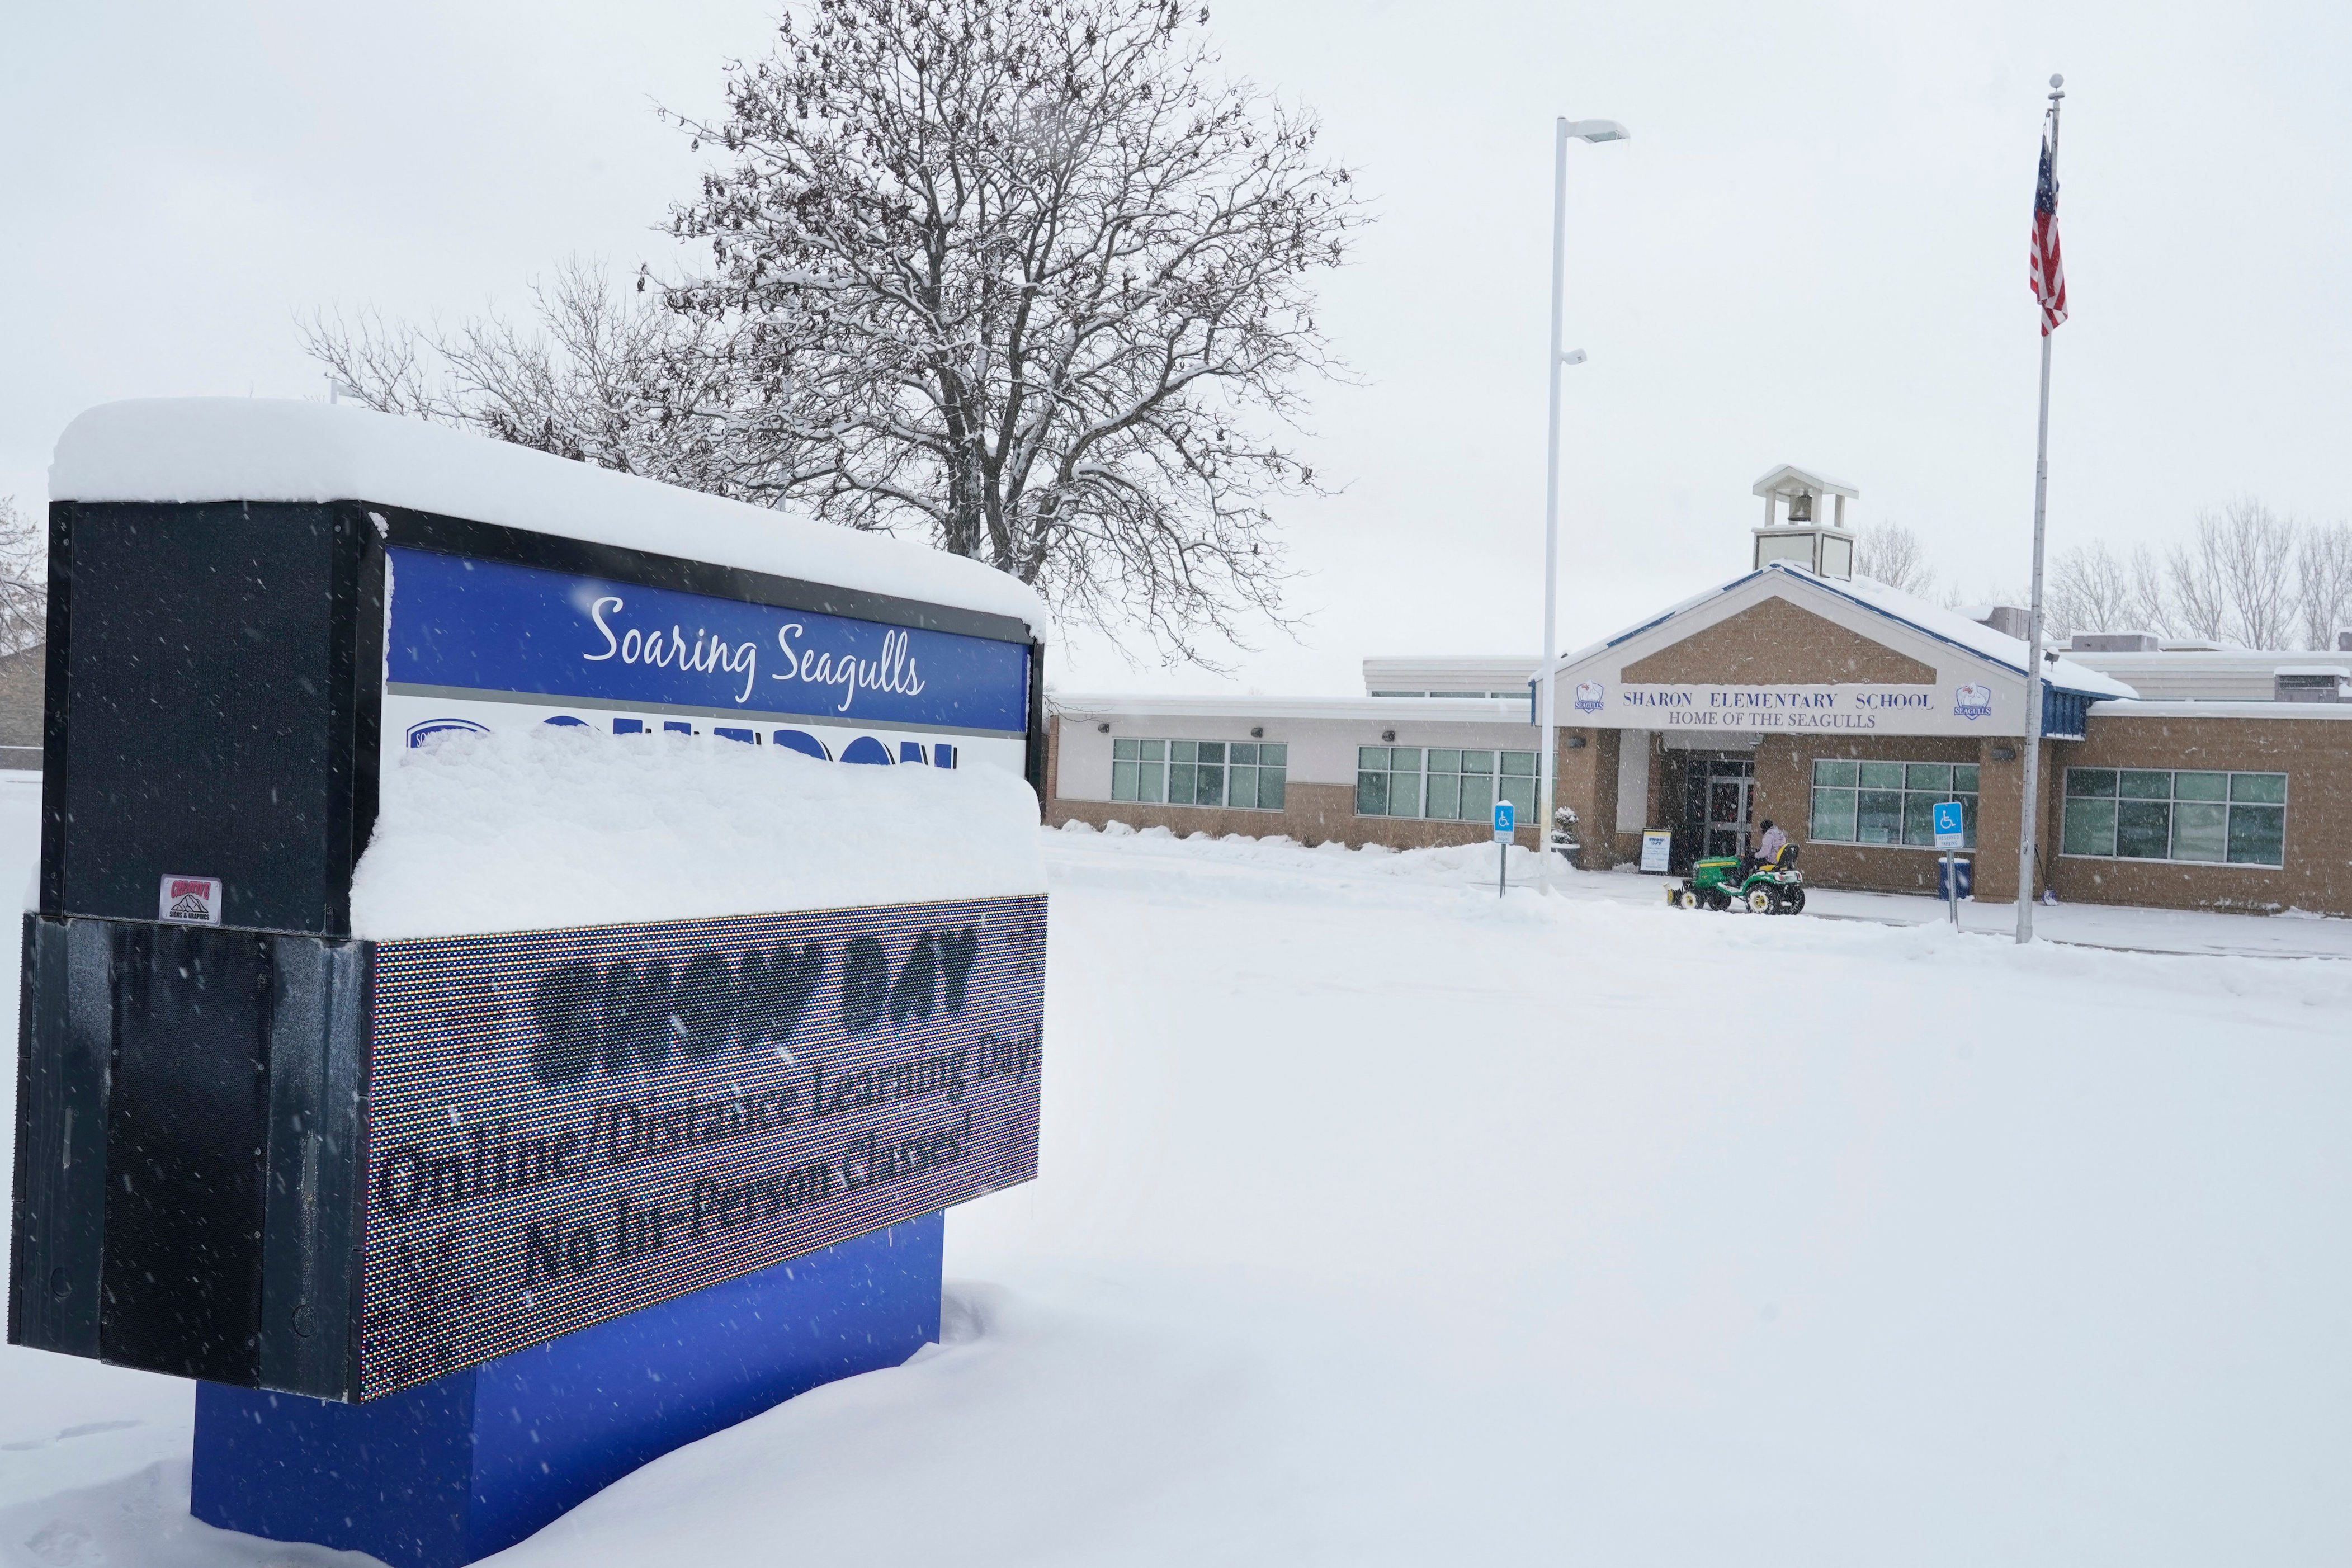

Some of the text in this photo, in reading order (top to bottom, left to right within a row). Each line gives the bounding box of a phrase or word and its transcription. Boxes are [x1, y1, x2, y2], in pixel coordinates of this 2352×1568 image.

[583, 596, 925, 712] Soaring Seagulls
[1575, 701, 1604, 710] SEAGULLS
[1623, 691, 1934, 710] SHARON ELEMENTARY SCHOOL
[1668, 711, 1876, 728] HOME OF THE SEAGULLS
[1954, 707, 1991, 716] SEAGULLS
[171, 880, 211, 900] CREATIVE
[531, 925, 979, 1087] SNOW DAY
[810, 1043, 967, 1118] Learning
[523, 1217, 598, 1287] No
[615, 1163, 829, 1259] In-Person
